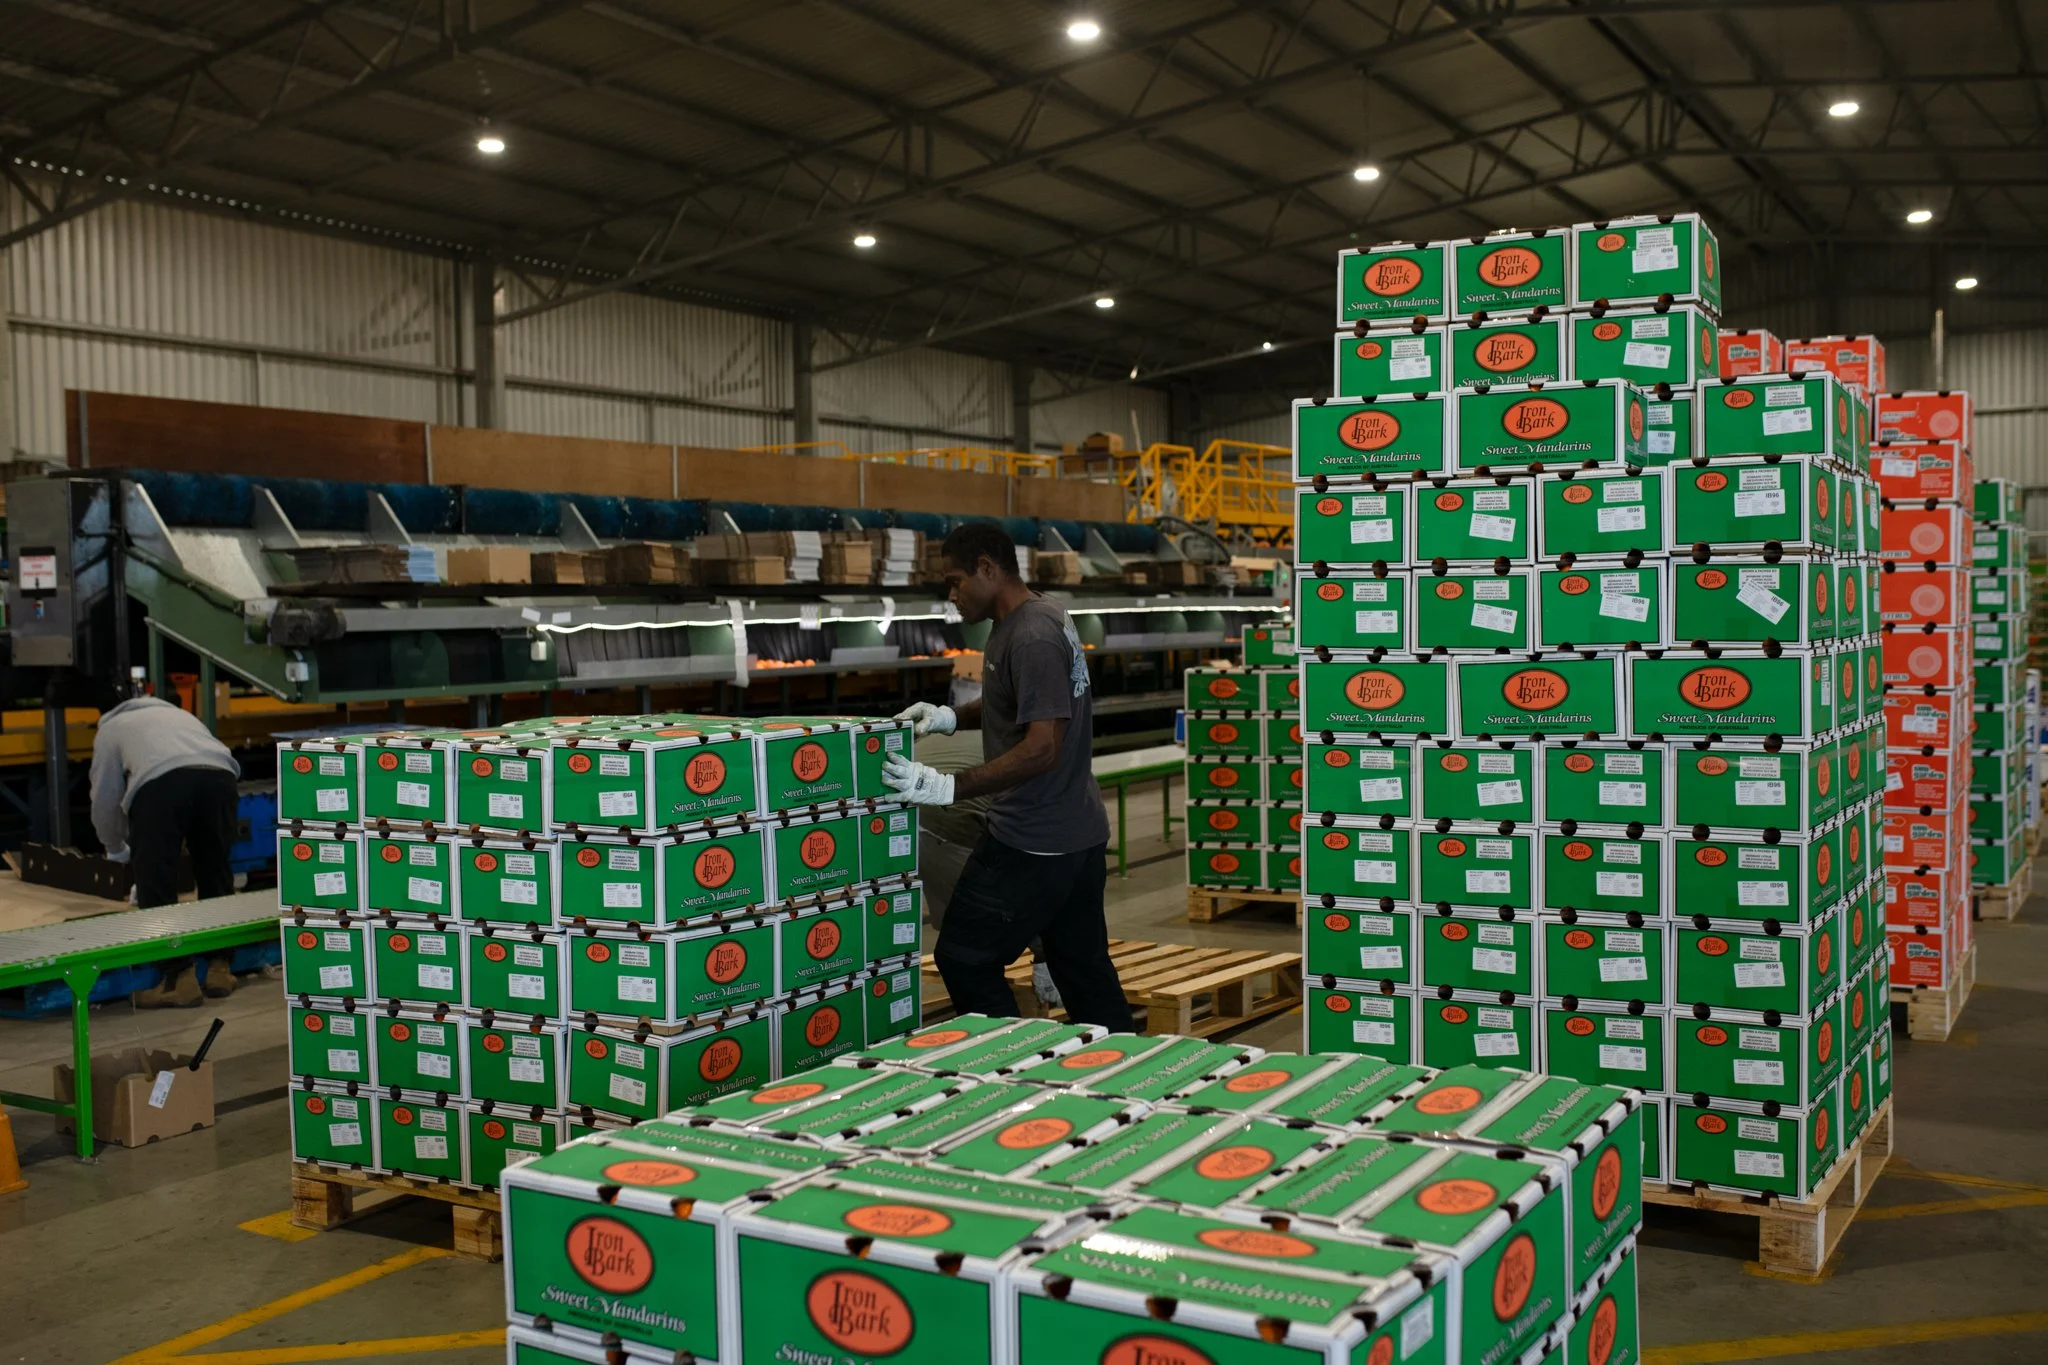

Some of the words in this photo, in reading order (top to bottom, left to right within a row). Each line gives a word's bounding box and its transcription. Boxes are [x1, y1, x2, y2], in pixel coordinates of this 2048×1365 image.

[1376, 264, 1403, 280] Iron
[1492, 254, 1520, 272] Iron
[1496, 261, 1529, 281] Bark
[1380, 270, 1410, 290] Bark
[1348, 302, 1378, 311] Sweet
[1380, 297, 1440, 308] Mandarins
[1462, 293, 1496, 303] Sweet
[1497, 286, 1561, 300] Mandarins
[1488, 340, 1516, 357] Iron
[1492, 344, 1524, 366] Bark
[1459, 378, 1491, 386] Sweet
[1517, 404, 1546, 422] Iron
[1521, 411, 1555, 433] Bark
[1352, 416, 1379, 433] Iron
[1355, 422, 1387, 444] Bark
[1319, 454, 1354, 465] Sweet
[1354, 450, 1422, 464] Mandarins
[1482, 444, 1519, 456] Sweet
[1520, 440, 1593, 455] Mandarins
[1358, 676, 1384, 692] Iron
[1517, 676, 1546, 692] Iron
[1521, 682, 1555, 703] Bark
[1695, 674, 1726, 691] Iron
[1699, 681, 1736, 702] Bark
[1361, 683, 1392, 703] Bark
[1326, 712, 1359, 721] Sweet
[1360, 712, 1426, 723] Mandarins
[1483, 714, 1519, 724] Sweet
[1520, 713, 1592, 724] Mandarins
[1658, 713, 1697, 723] Sweet
[1698, 712, 1776, 723] Mandarins
[800, 750, 816, 766] Iron
[803, 754, 821, 775] Bark
[693, 759, 712, 778] Iron
[697, 764, 717, 787] Bark
[781, 787, 802, 798] Sweet
[803, 782, 842, 795] Mandarins
[672, 802, 695, 812] Sweet
[696, 794, 742, 808] Mandarins
[808, 836, 823, 852] Iron
[810, 840, 828, 862] Bark
[702, 853, 721, 871] Iron
[705, 857, 727, 882] Bark
[789, 875, 809, 886] Sweet
[810, 868, 849, 882] Mandarins
[681, 895, 704, 907] Sweet
[705, 887, 750, 902] Mandarins
[813, 926, 829, 944] Iron
[815, 931, 833, 953] Bark
[714, 947, 732, 966] Iron
[716, 953, 738, 977] Bark
[794, 966, 815, 978] Sweet
[816, 956, 852, 971] Mandarins
[692, 991, 716, 1003] Sweet
[717, 981, 760, 996] Mandarins
[813, 1013, 828, 1031] Iron
[815, 1019, 833, 1041] Bark
[708, 1045, 727, 1065] Iron
[711, 1051, 733, 1075] Bark
[794, 1054, 815, 1068] Sweet
[815, 1042, 853, 1060] Mandarins
[684, 1090, 710, 1104] Sweet
[711, 1075, 756, 1094] Mandarins
[584, 1226, 623, 1259] Iron
[592, 1248, 635, 1276] Bark
[541, 1285, 589, 1310] Sweet
[590, 1296, 686, 1333] Mandarins
[829, 1281, 876, 1317] Iron
[837, 1303, 890, 1336] Bark
[775, 1344, 834, 1365] Sweet
